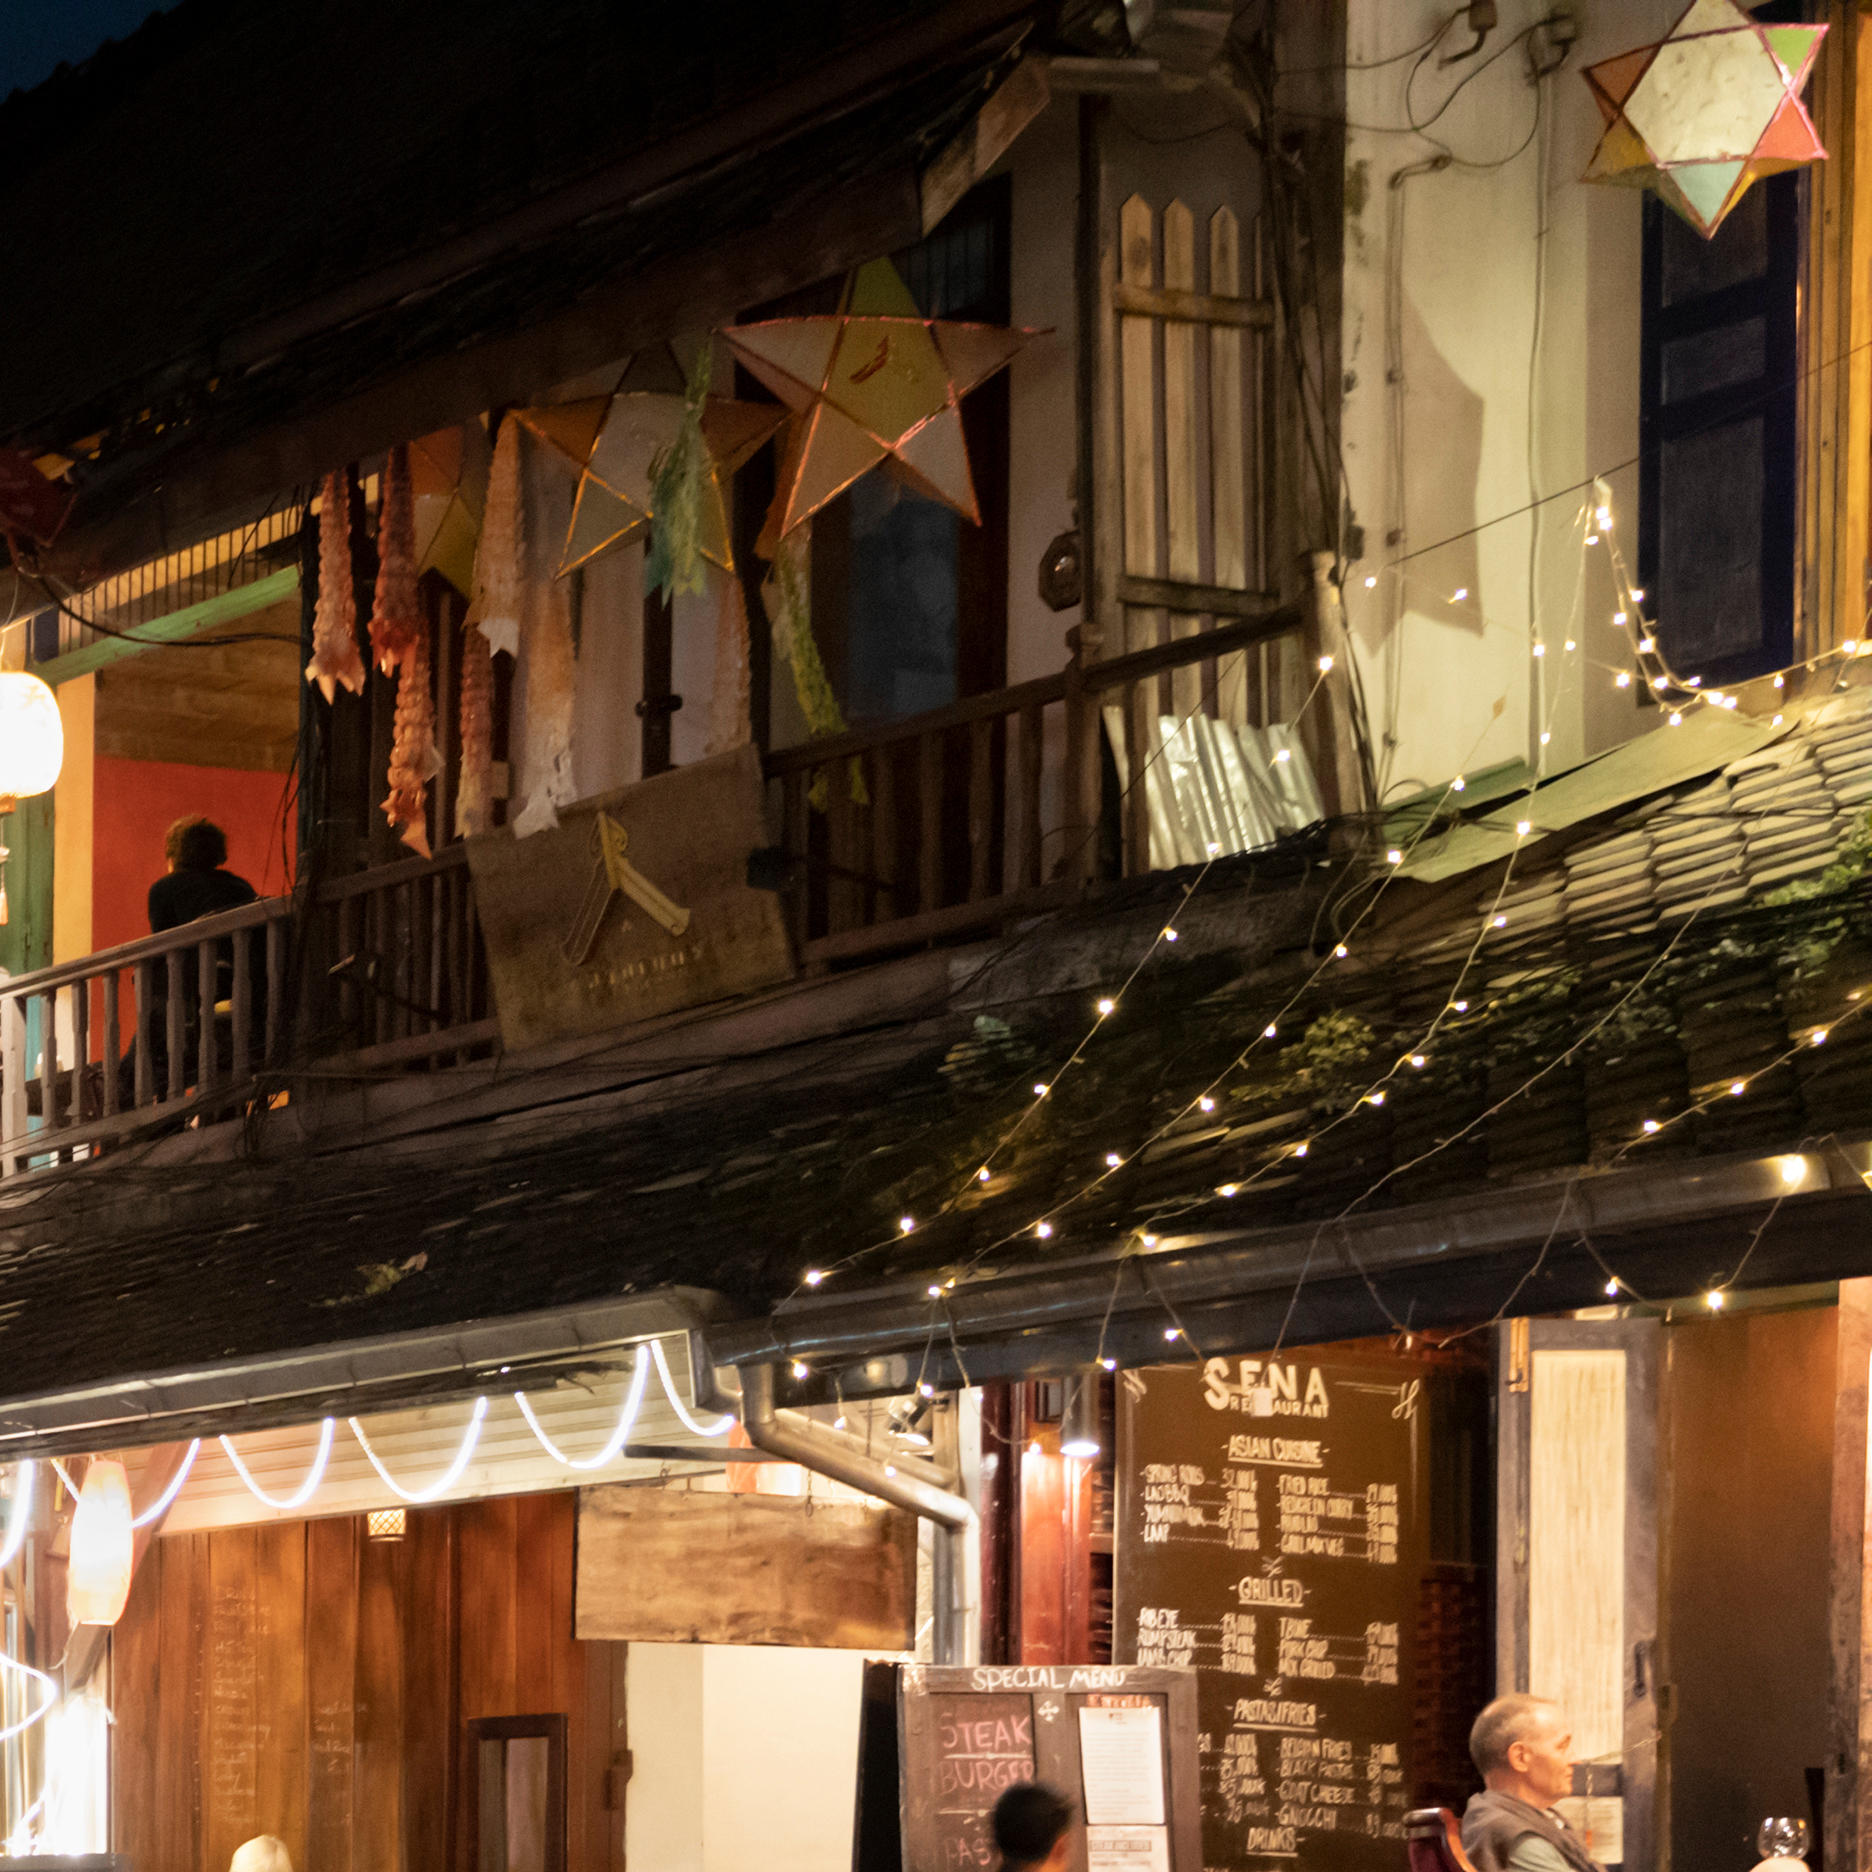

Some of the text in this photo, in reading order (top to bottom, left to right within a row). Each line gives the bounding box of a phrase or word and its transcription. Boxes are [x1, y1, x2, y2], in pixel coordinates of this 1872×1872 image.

[1203, 1357, 1329, 1411] SENA
[1230, 1399, 1329, 1418] REAURANT
[1229, 1434, 1321, 1463] ASIAN CUISINE
[1238, 1576, 1304, 1603] GRILLED
[971, 1668, 1126, 1691] SPECIAL MENU
[940, 1712, 1033, 1753] STEAK
[938, 1760, 1034, 1794] BURGER
[1278, 1805, 1337, 1830] GNOCCHI
[1246, 1827, 1297, 1852] DRINKS
